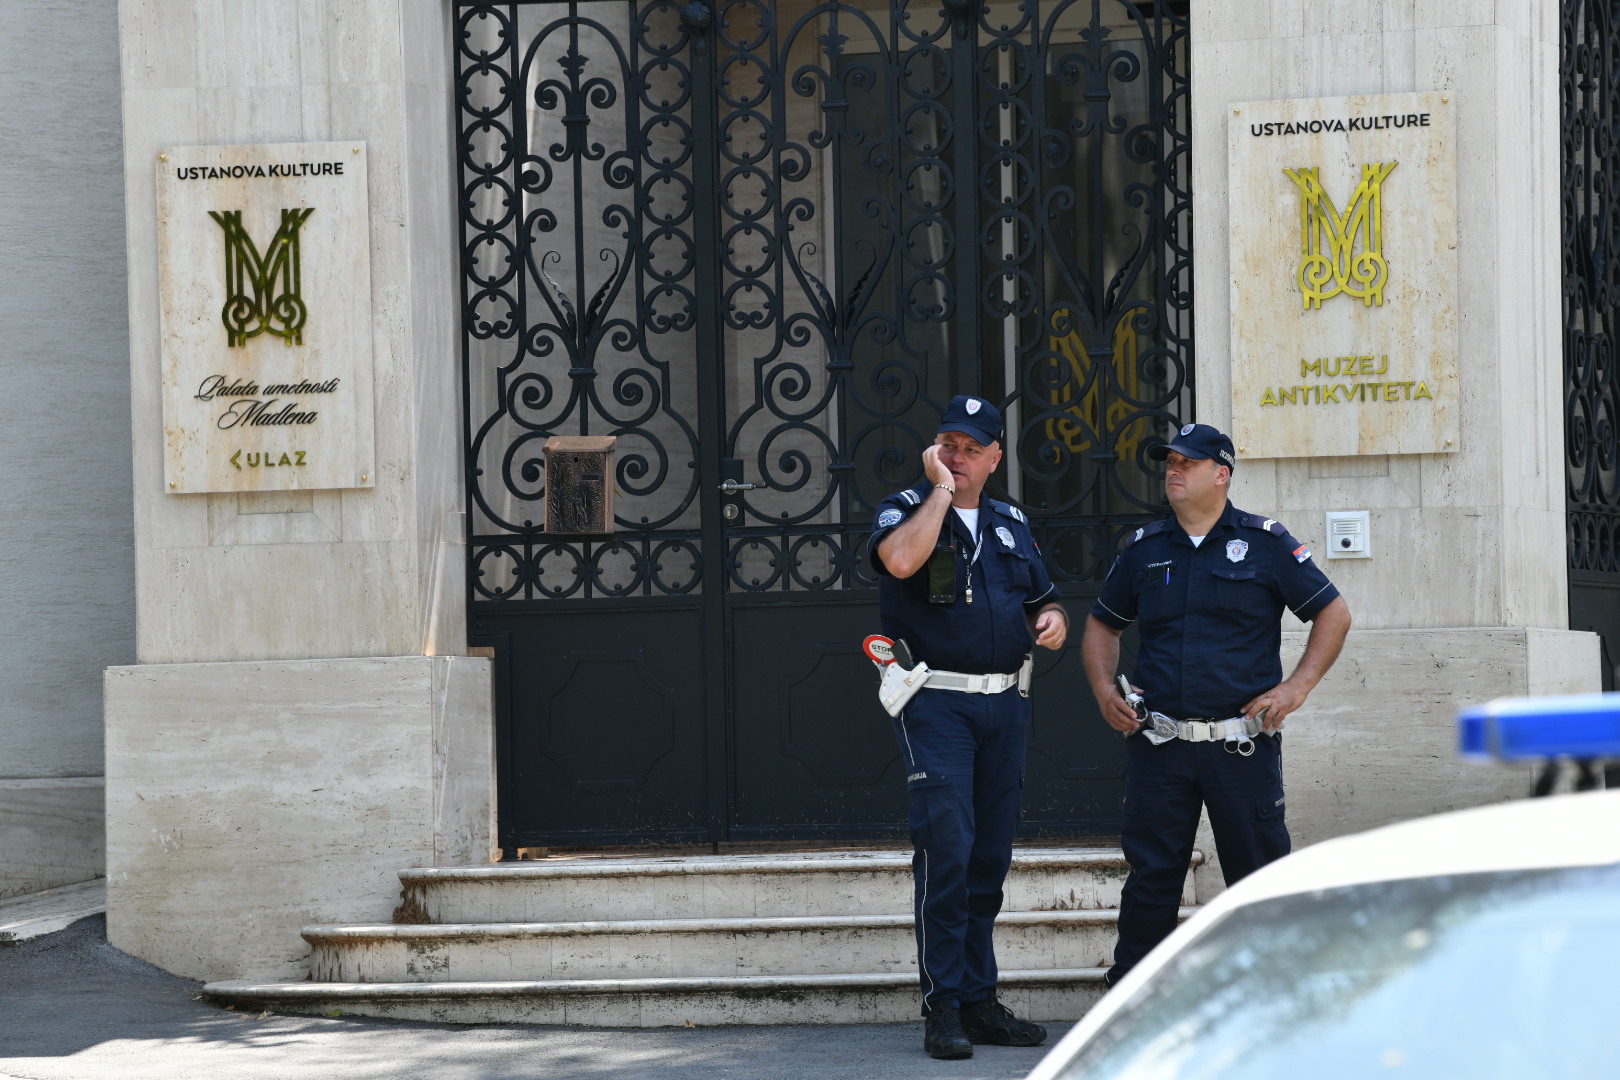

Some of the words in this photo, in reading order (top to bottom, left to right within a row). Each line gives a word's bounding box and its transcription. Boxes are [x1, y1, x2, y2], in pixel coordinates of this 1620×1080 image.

[1251, 118, 1346, 137] USTANOVA
[1348, 113, 1431, 132] KULTURE
[177, 164, 266, 181] USTANOVA
[268, 162, 344, 178] KULTURE
[1301, 354, 1388, 377] MUZEJ
[193, 374, 260, 402] Palata
[262, 377, 341, 396] umetnosti
[1260, 381, 1432, 406] ANTIKVITETA
[217, 398, 318, 430] Madlena
[247, 450, 307, 468] ULAZ
